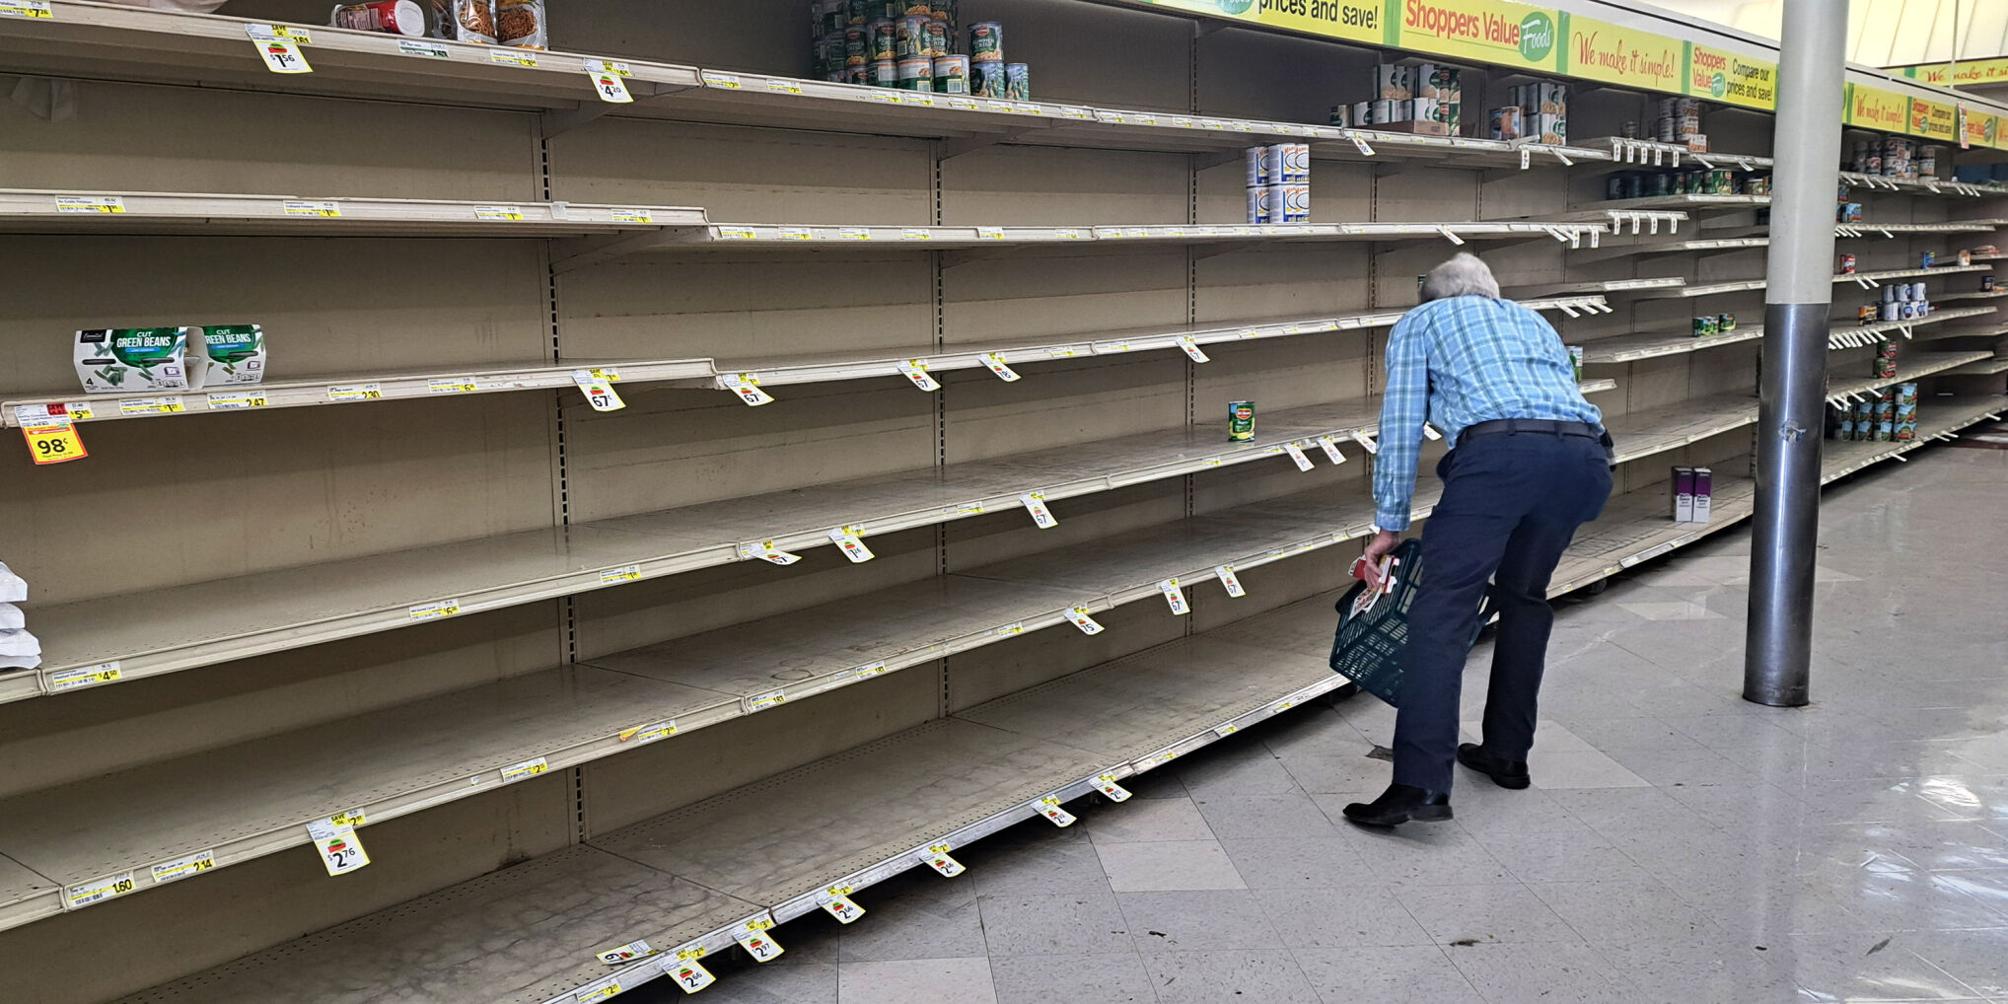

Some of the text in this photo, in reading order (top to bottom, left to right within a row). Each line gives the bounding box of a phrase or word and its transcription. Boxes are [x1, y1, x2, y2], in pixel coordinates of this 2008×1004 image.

[1311, 0, 1338, 22] and
[1342, 5, 1378, 29] save!
[1405, 0, 1520, 46] Shoppers Value
[1573, 31, 1676, 87] We make it simple!
[1693, 47, 1727, 72] Shoppers
[1732, 58, 1771, 82] Compare our
[1692, 67, 1712, 89] Value
[1726, 80, 1746, 97] prices
[1745, 83, 1758, 99] and
[116, 336, 172, 348] GREEN BEANS
[204, 333, 252, 345] REEN BEANS
[86, 377, 94, 385] 4
